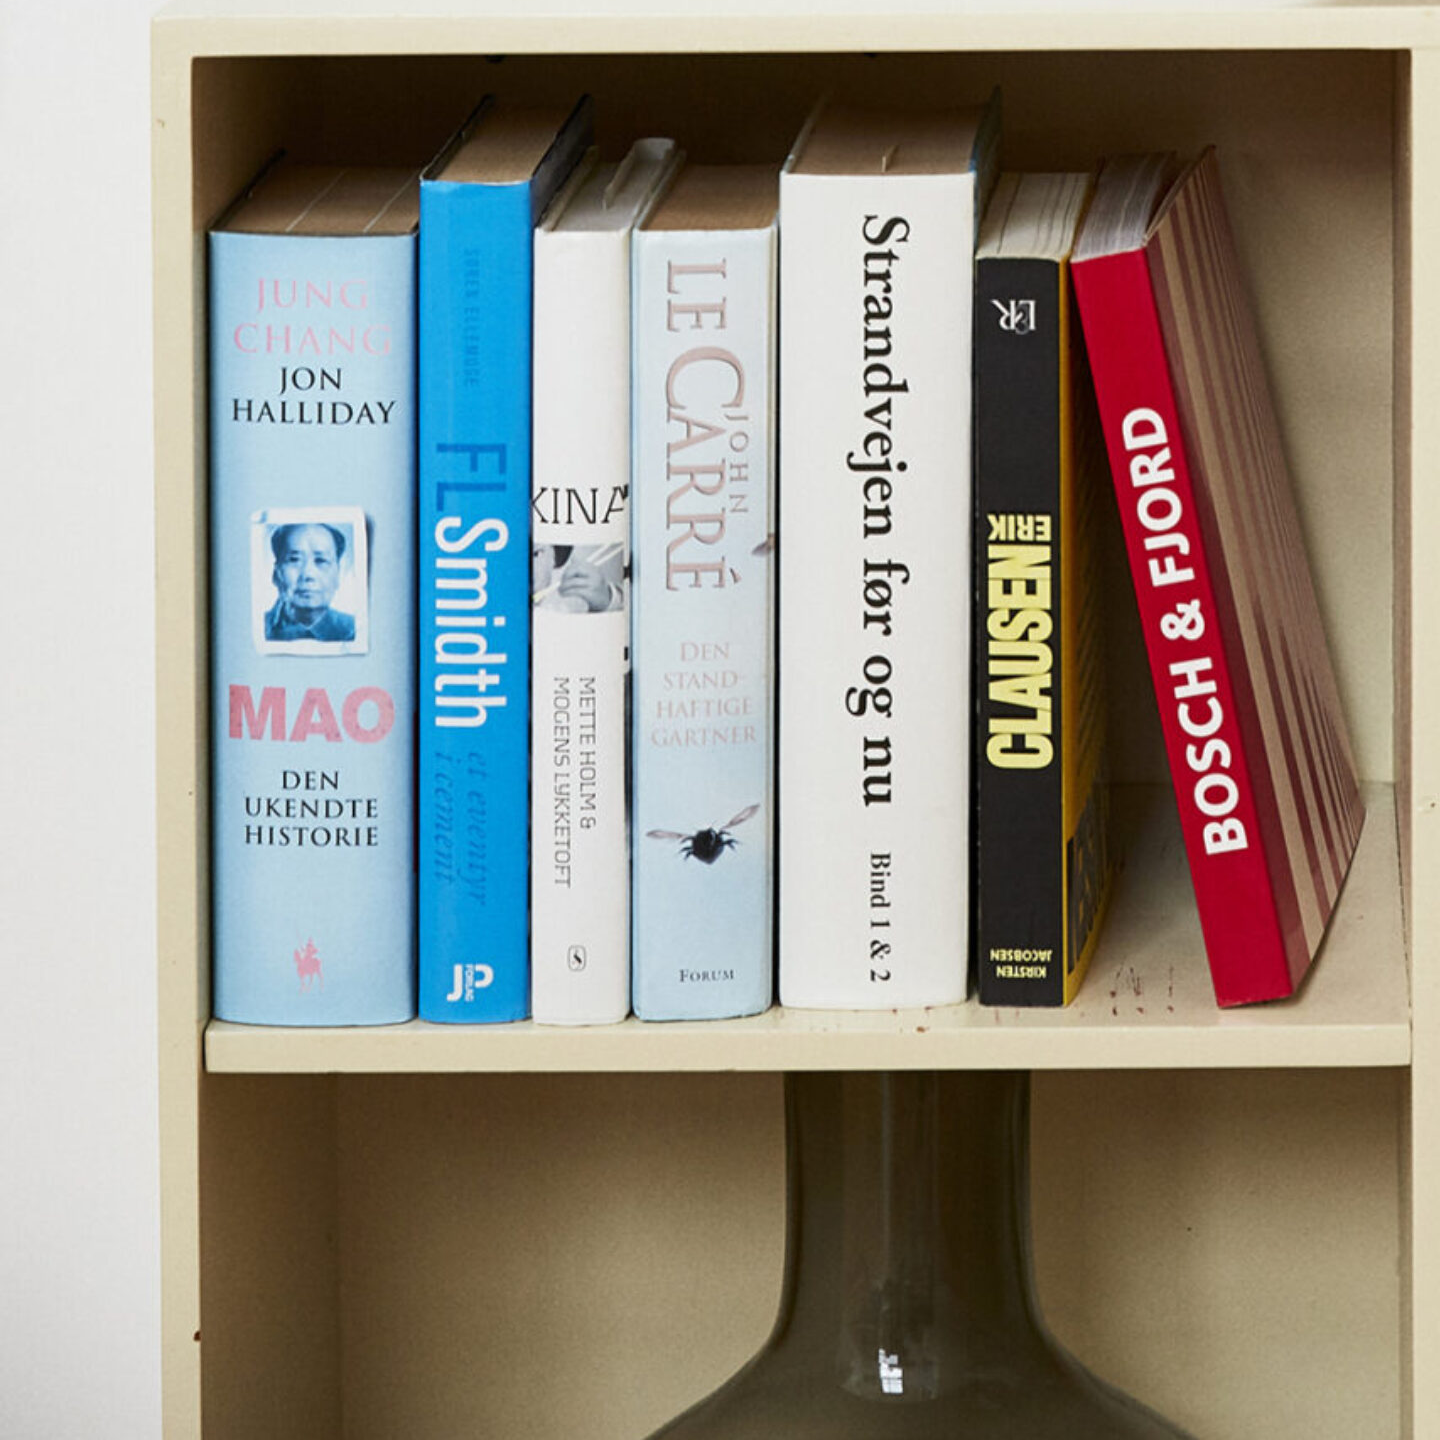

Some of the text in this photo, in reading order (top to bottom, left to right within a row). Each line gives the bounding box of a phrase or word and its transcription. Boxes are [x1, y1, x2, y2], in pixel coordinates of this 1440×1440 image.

[258, 278, 367, 312] JUNG
[233, 321, 393, 357] CHANG
[281, 368, 341, 394] JON
[847, 216, 910, 538] Strandvejen
[233, 399, 395, 424] HALLIDAY
[665, 259, 745, 592] LE CARRÉ
[724, 413, 749, 514] JOHN
[988, 515, 1051, 541] ERIK
[864, 559, 910, 636] før
[1122, 408, 1248, 854] BOSCH & FJORD
[681, 642, 729, 661] DEN
[987, 545, 1053, 768] CLAUSEN
[847, 655, 892, 719] og
[228, 684, 398, 743] MAO
[656, 698, 753, 719] HAFTIGE
[580, 677, 596, 829] METTE HOLM &
[651, 725, 757, 748] GARTNER
[283, 771, 338, 790] DEN
[554, 677, 570, 887] MOGENS LYKKETOFT
[863, 737, 891, 806] nu
[246, 797, 377, 818] UKENDTE
[246, 825, 377, 846] HISTORIE
[434, 772, 459, 887] cement
[461, 752, 491, 907] et eventyr
[871, 854, 891, 907] Bind
[871, 940, 890, 958] &
[990, 949, 1052, 961] JACOBSEN
[871, 970, 891, 981] 2
[997, 966, 1046, 977] KIRSTEN
